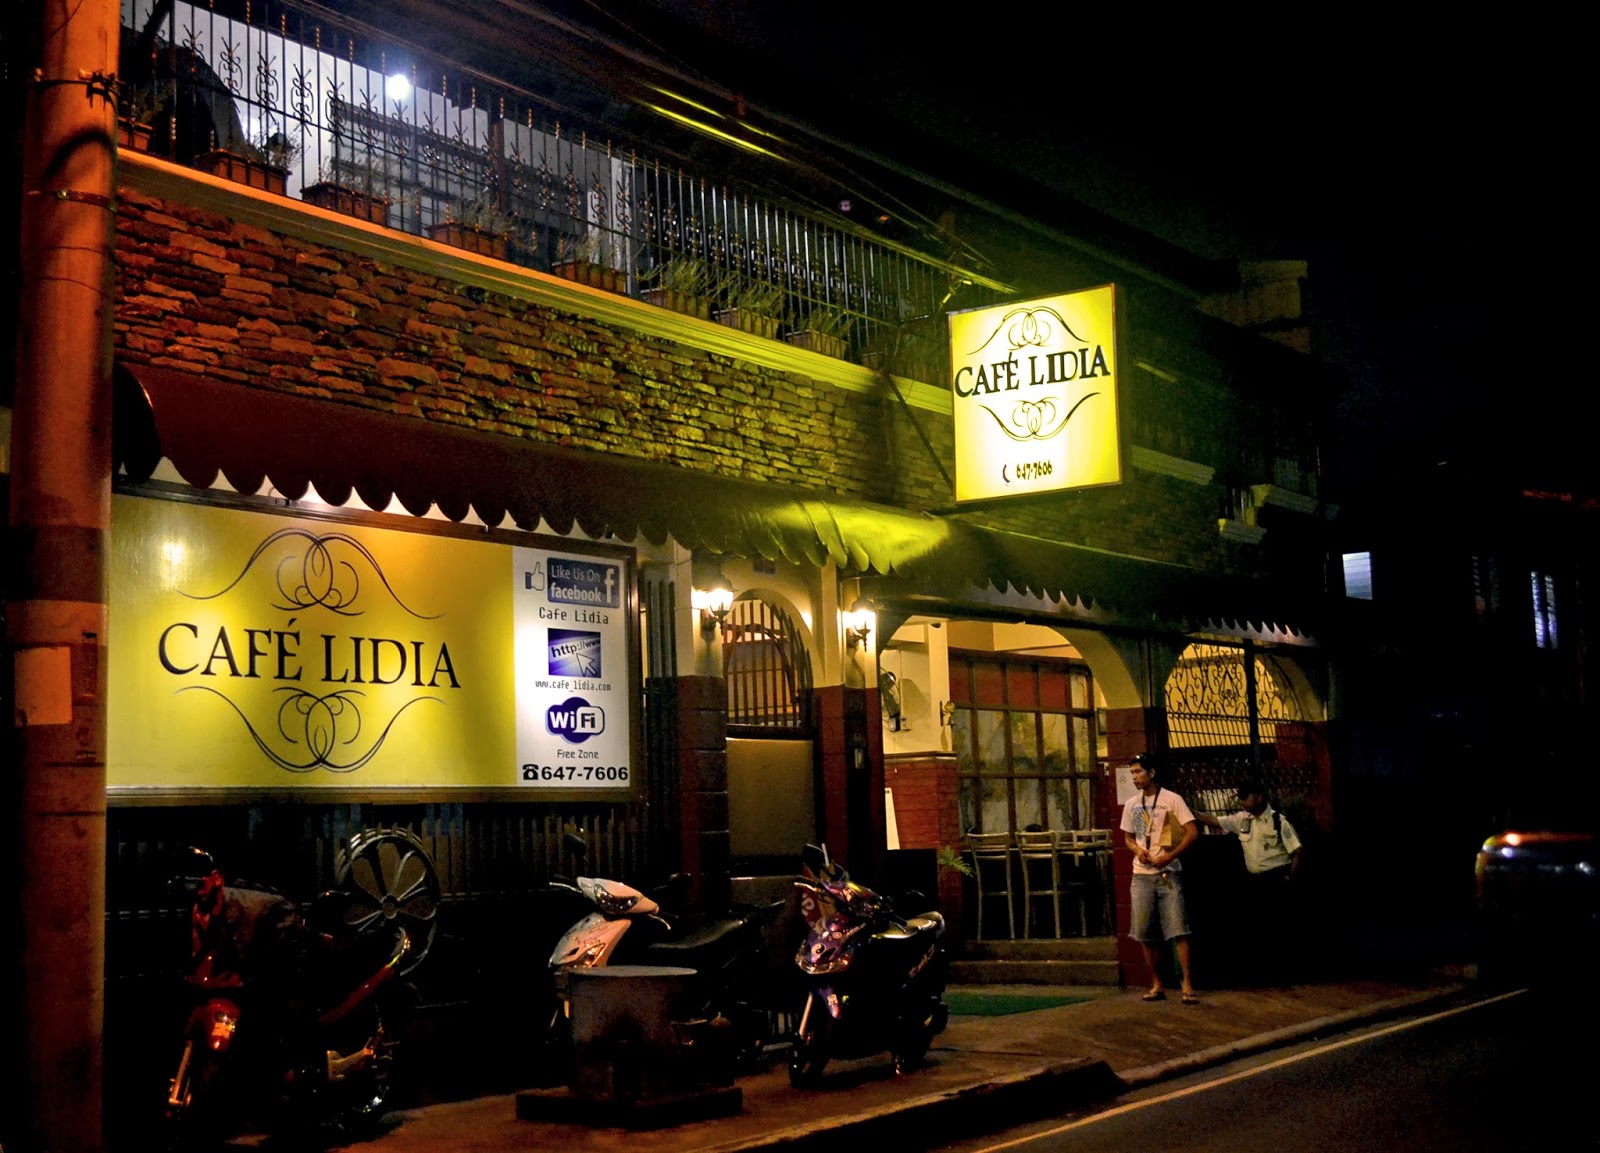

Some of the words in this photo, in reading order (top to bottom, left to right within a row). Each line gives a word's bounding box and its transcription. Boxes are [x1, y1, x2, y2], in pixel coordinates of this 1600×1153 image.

[954, 351, 1020, 398] CAFÉ
[1028, 344, 1111, 387] LIDIA
[1016, 459, 1053, 480] 647-7606
[551, 564, 571, 580] Like
[573, 567, 585, 581] Us
[587, 568, 600, 582] On
[550, 582, 602, 602] facebook
[539, 606, 567, 621] Cafe
[574, 609, 609, 625] Lidia
[158, 618, 303, 679] CAFÉ
[321, 633, 462, 689] LIDIA
[535, 679, 612, 693] www.cafe_lidia.com
[557, 748, 576, 759] Free
[578, 749, 599, 759] Zone
[541, 766, 629, 781] 647-7606
